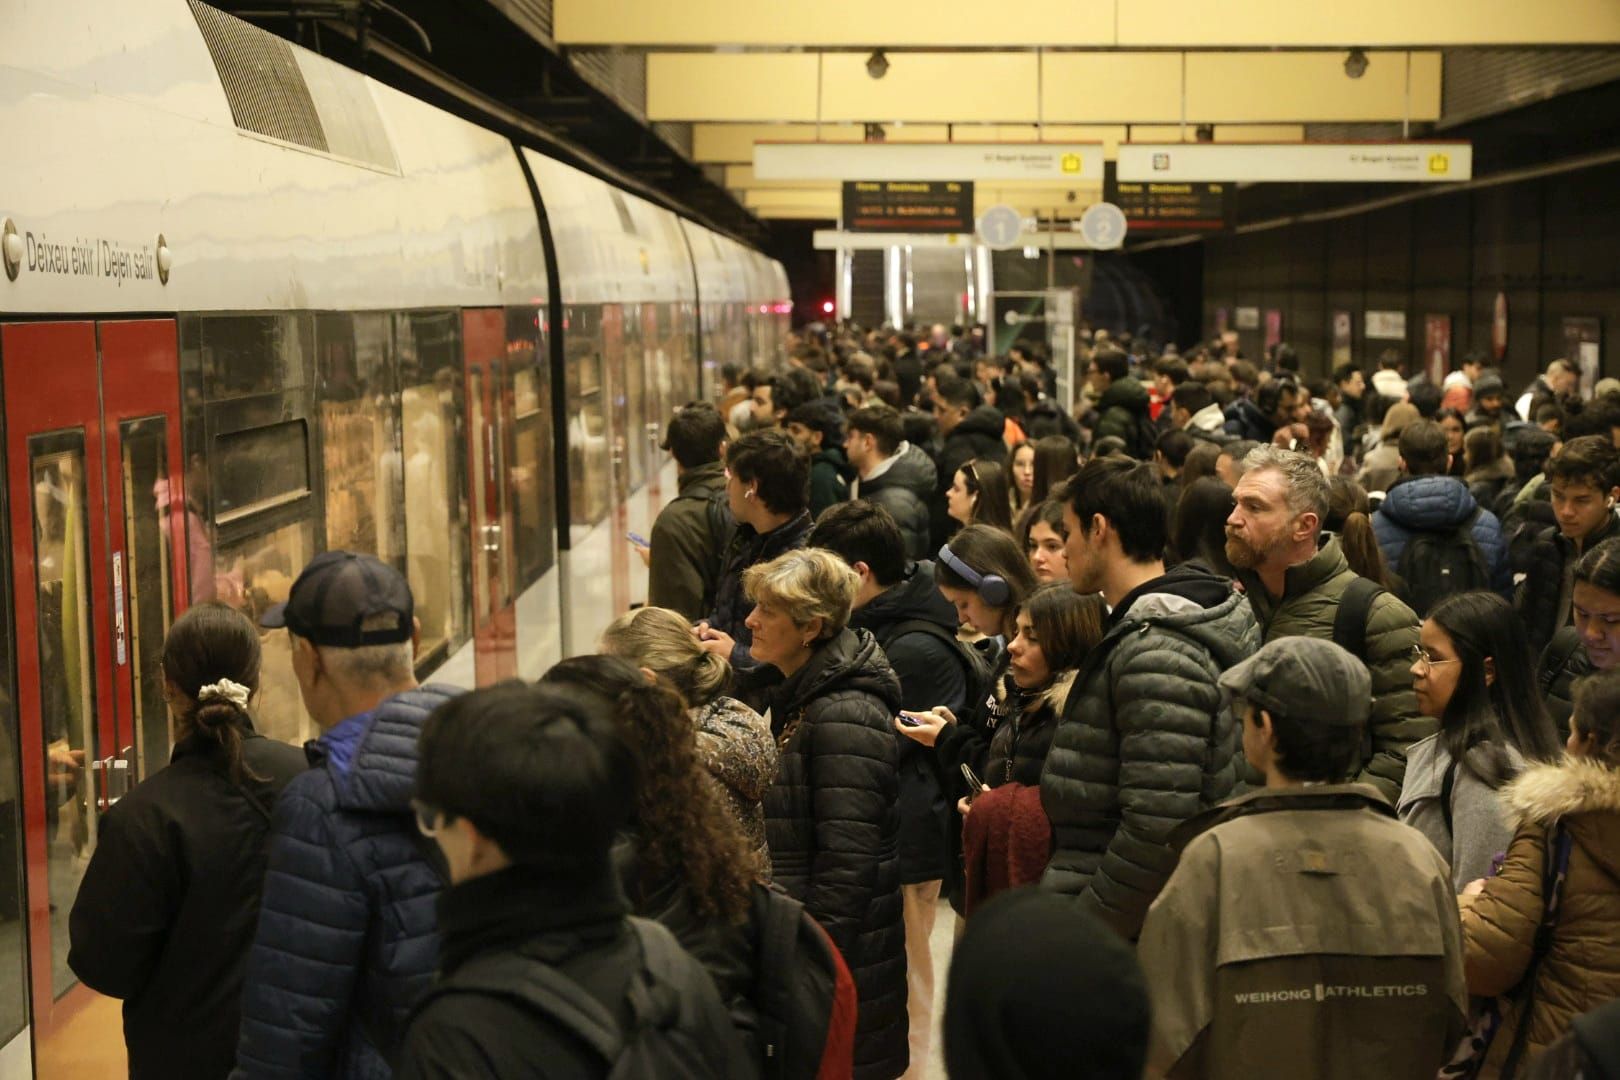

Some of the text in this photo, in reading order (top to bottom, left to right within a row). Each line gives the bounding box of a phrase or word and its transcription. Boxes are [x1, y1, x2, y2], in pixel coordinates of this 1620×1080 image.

[994, 221, 1006, 242] 1
[1096, 221, 1112, 242] 2
[26, 231, 69, 274] Deixeu
[71, 236, 94, 276] eixir
[102, 239, 132, 288] Dejen
[133, 245, 153, 280] salir
[1234, 984, 1428, 1004] WEIHONG ATHLETICS
